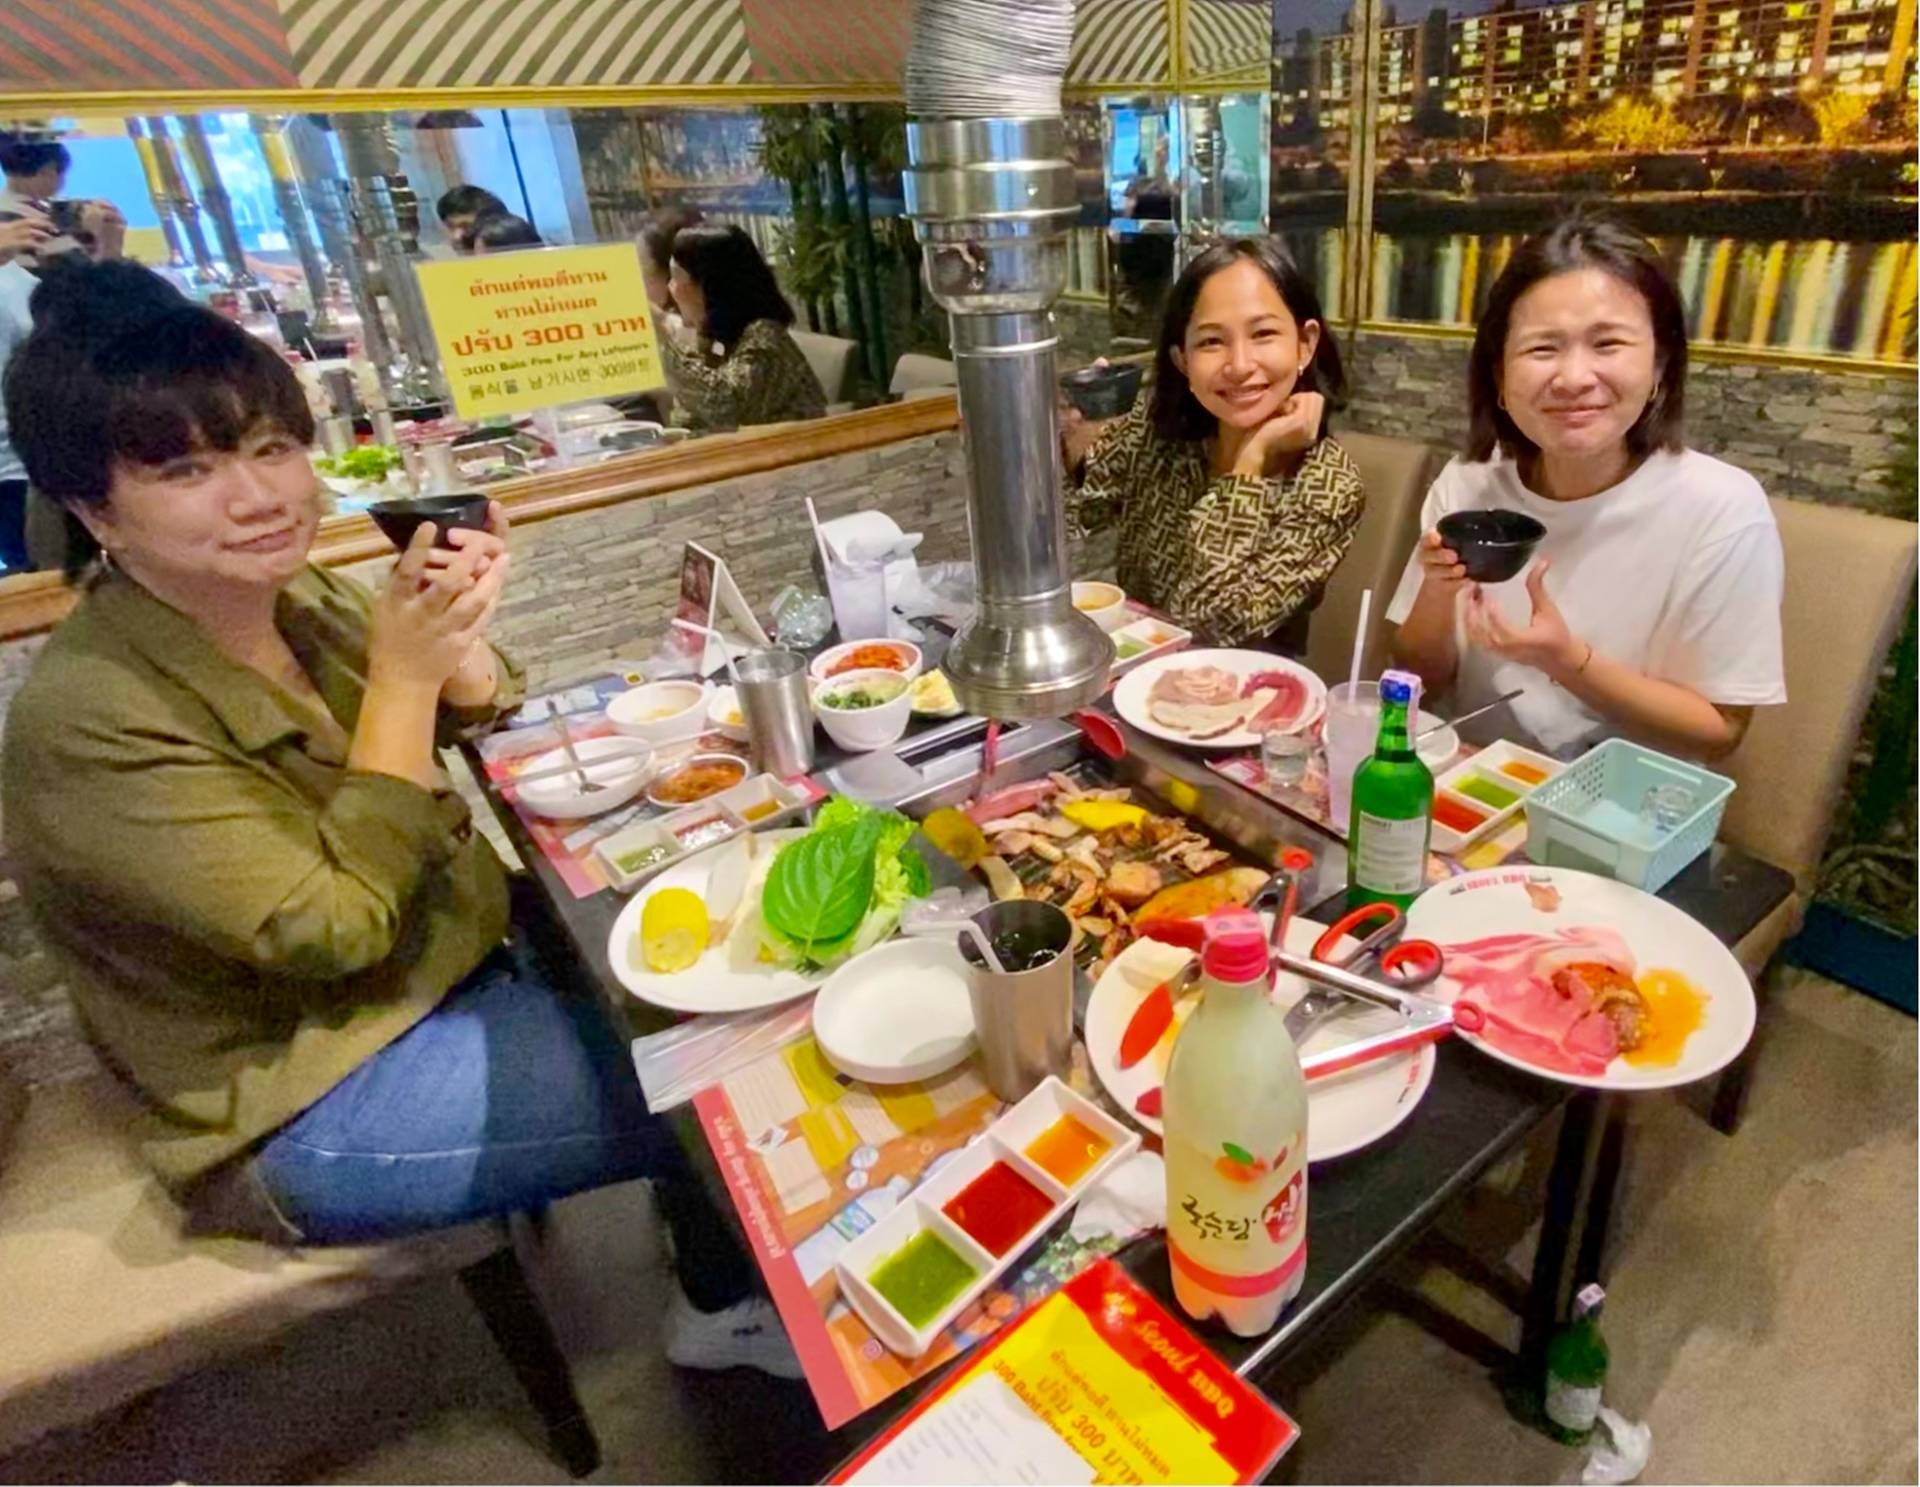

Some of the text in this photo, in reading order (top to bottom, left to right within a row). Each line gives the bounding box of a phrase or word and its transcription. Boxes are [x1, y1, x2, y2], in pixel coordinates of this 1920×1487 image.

[451, 316, 647, 356] ปรับ 300 บาท
[462, 363, 496, 377] 300
[1133, 1320, 1199, 1374] Seoul
[1071, 1414, 1107, 1449] 300
